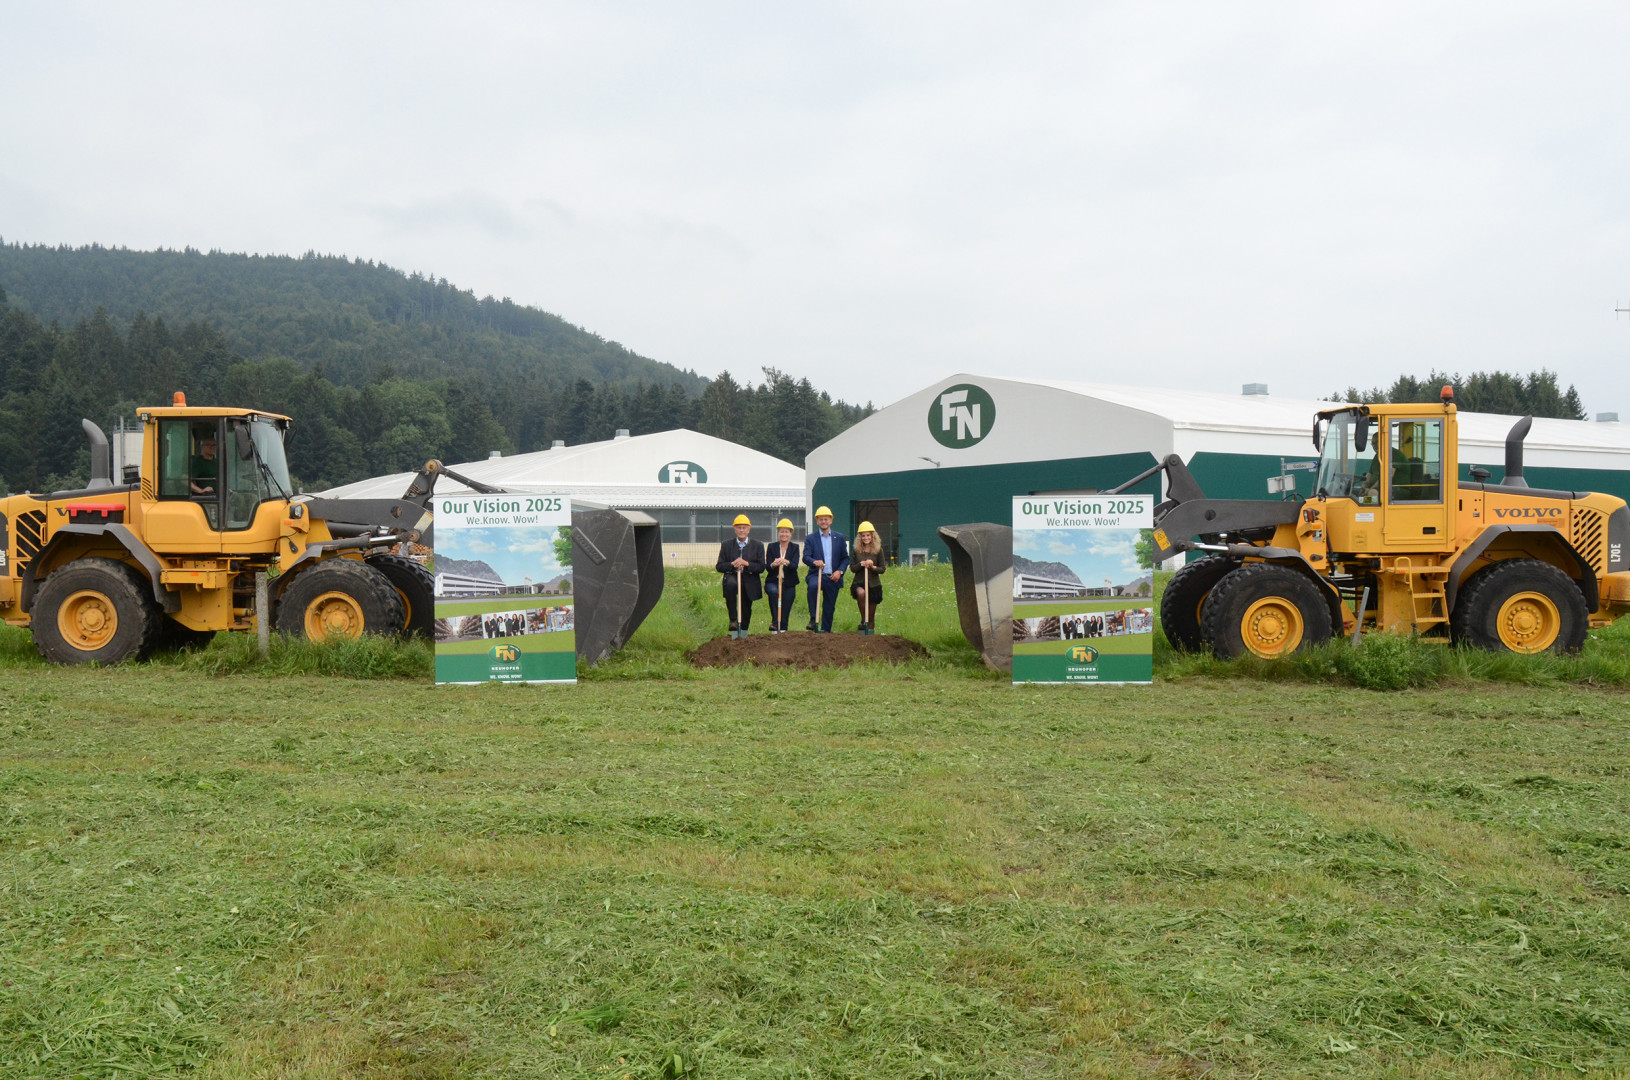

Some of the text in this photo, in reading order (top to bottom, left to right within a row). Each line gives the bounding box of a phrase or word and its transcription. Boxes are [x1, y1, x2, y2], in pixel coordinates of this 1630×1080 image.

[940, 389, 981, 440] FN
[667, 463, 697, 483] FN
[442, 498, 562, 514] Our Vision 2025
[1022, 500, 1144, 515] Our Vision 2025
[1493, 507, 1562, 518] VOLVO
[512, 515, 539, 524] Wow!
[1094, 517, 1120, 526] Wow!
[1610, 543, 1621, 562] L70E
[495, 645, 516, 662] FN
[1072, 646, 1093, 663] FN
